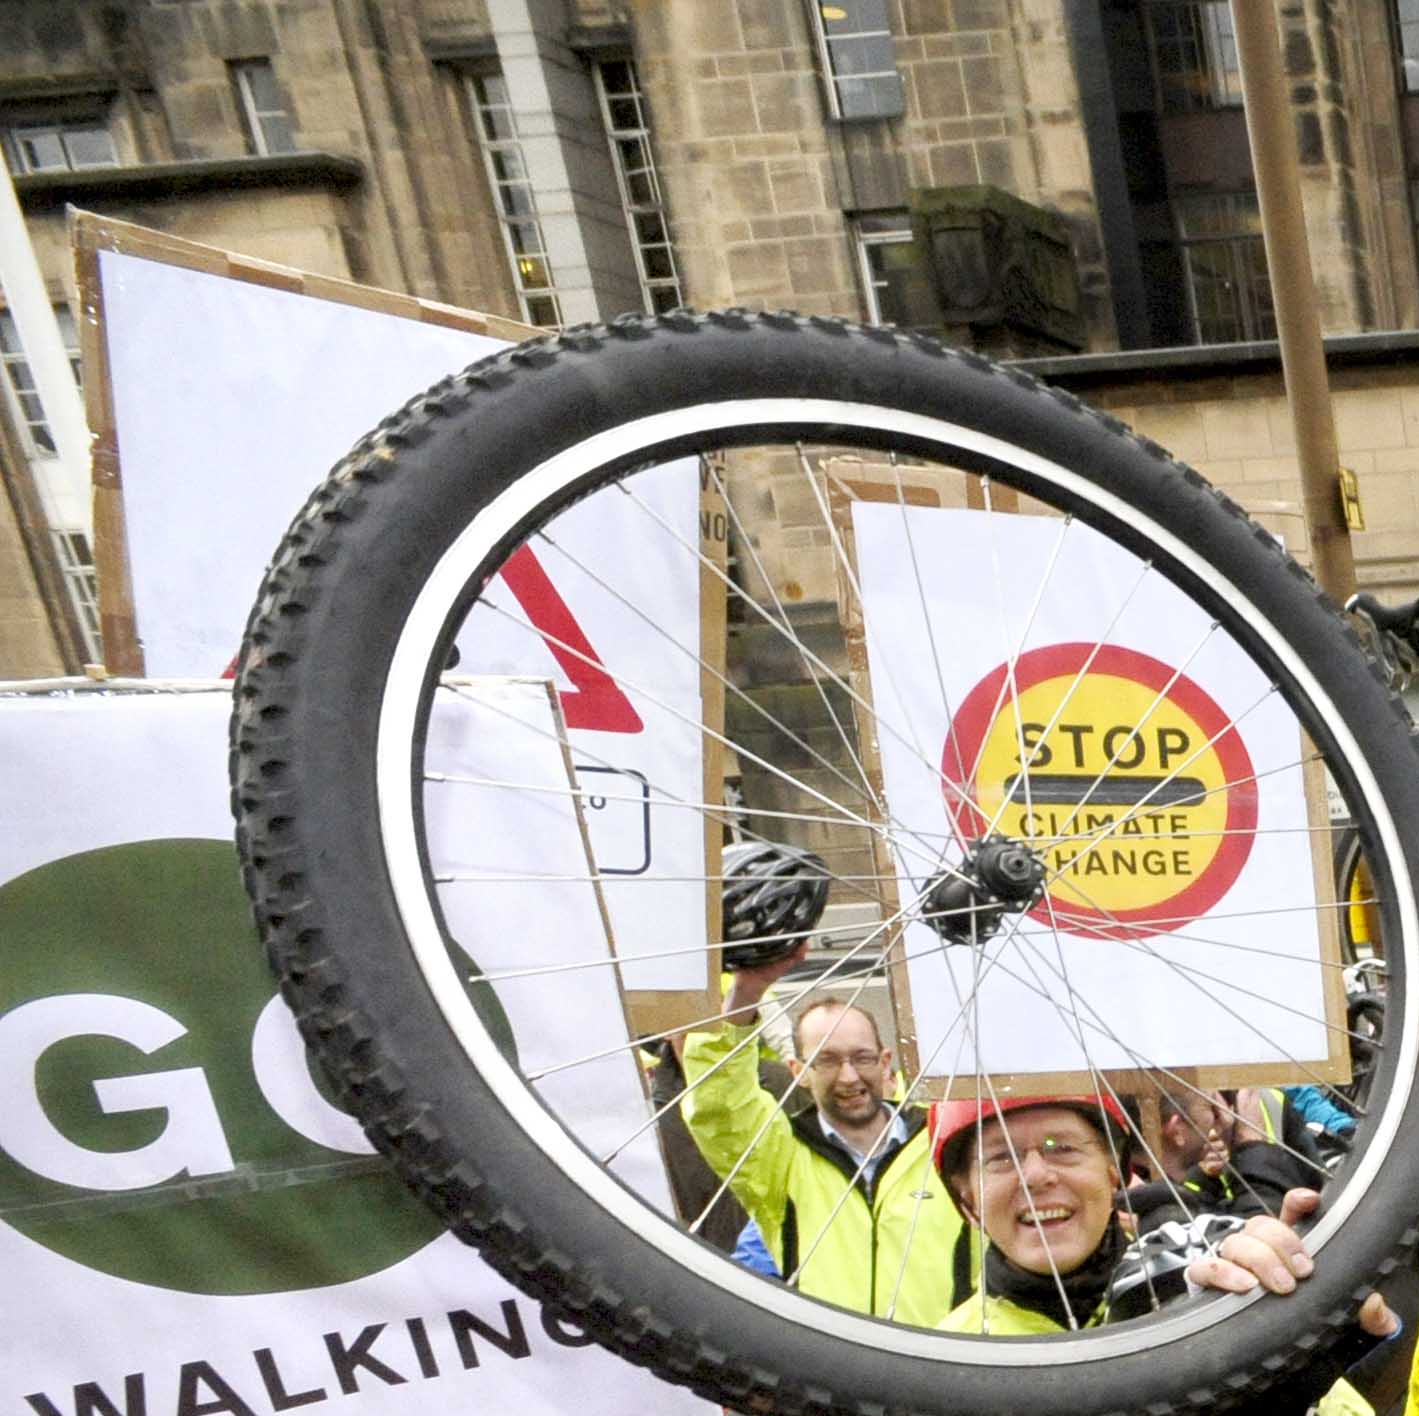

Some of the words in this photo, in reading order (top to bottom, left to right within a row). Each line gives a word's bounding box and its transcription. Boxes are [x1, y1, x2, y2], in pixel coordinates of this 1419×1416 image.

[1014, 722, 1191, 770] STOP
[1018, 812, 1191, 840] CLIMATE
[1035, 849, 1193, 877] HANGE
